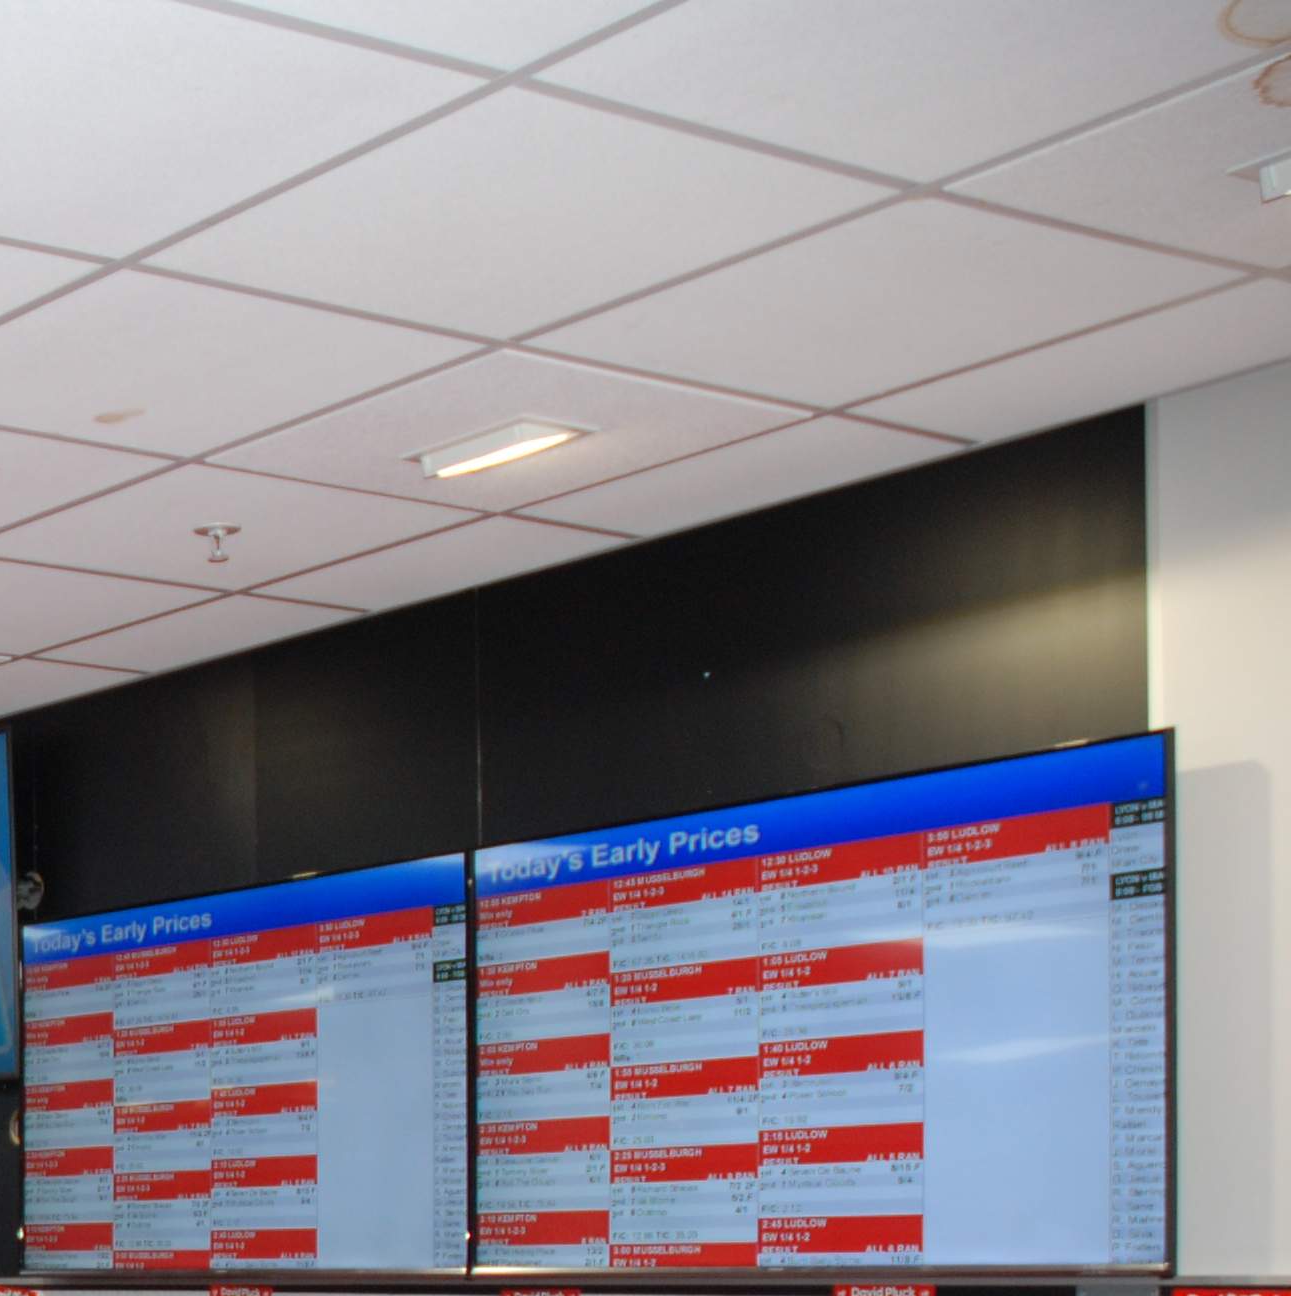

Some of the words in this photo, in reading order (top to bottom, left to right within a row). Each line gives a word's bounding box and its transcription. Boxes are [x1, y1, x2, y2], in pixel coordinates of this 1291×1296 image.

[952, 823, 1002, 839] LUDLOW
[489, 851, 584, 883] Today's
[591, 838, 660, 867] Early
[669, 823, 760, 855] Prices
[788, 848, 833, 864] LUDLOW
[637, 867, 706, 885] MUSSELBURGH
[334, 918, 366, 931] LUDLOW
[34, 930, 96, 954] Today's
[101, 921, 147, 943] Early
[153, 912, 212, 936] Prices
[785, 950, 828, 964] LUDLOW
[634, 965, 703, 982] MUSSELBURGH
[785, 1040, 828, 1053] LUDLOW
[634, 1061, 703, 1076] MUSSELBURGH
[785, 1129, 828, 1141] LUDLOW
[634, 1147, 703, 1160] MUSSELBURGH
[784, 1217, 827, 1229] LUDLOW
[633, 1245, 702, 1255] MUSSELBURGH
